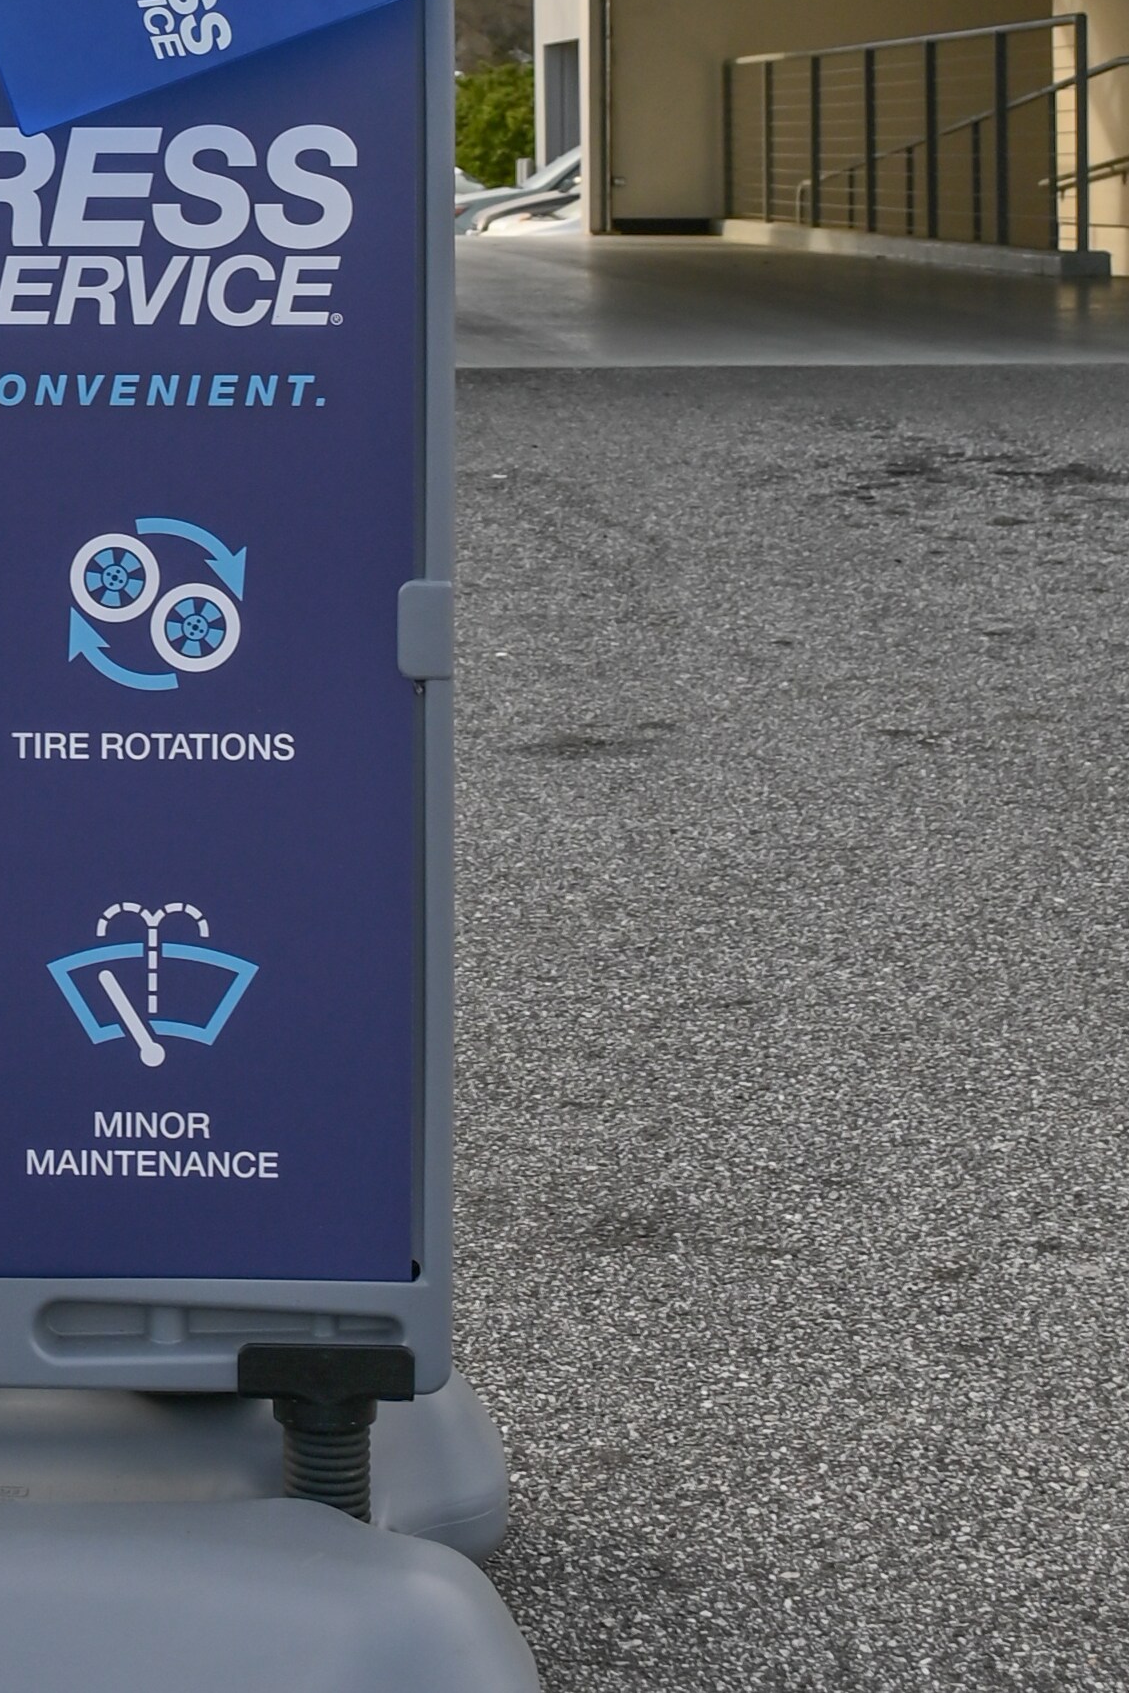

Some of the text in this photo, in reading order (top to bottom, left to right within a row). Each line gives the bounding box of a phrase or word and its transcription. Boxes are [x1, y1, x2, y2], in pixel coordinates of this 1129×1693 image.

[11, 732, 295, 761] TIRE ROTATIONS
[94, 1111, 210, 1139] MINOR
[26, 1149, 279, 1179] MAINTENANCE
